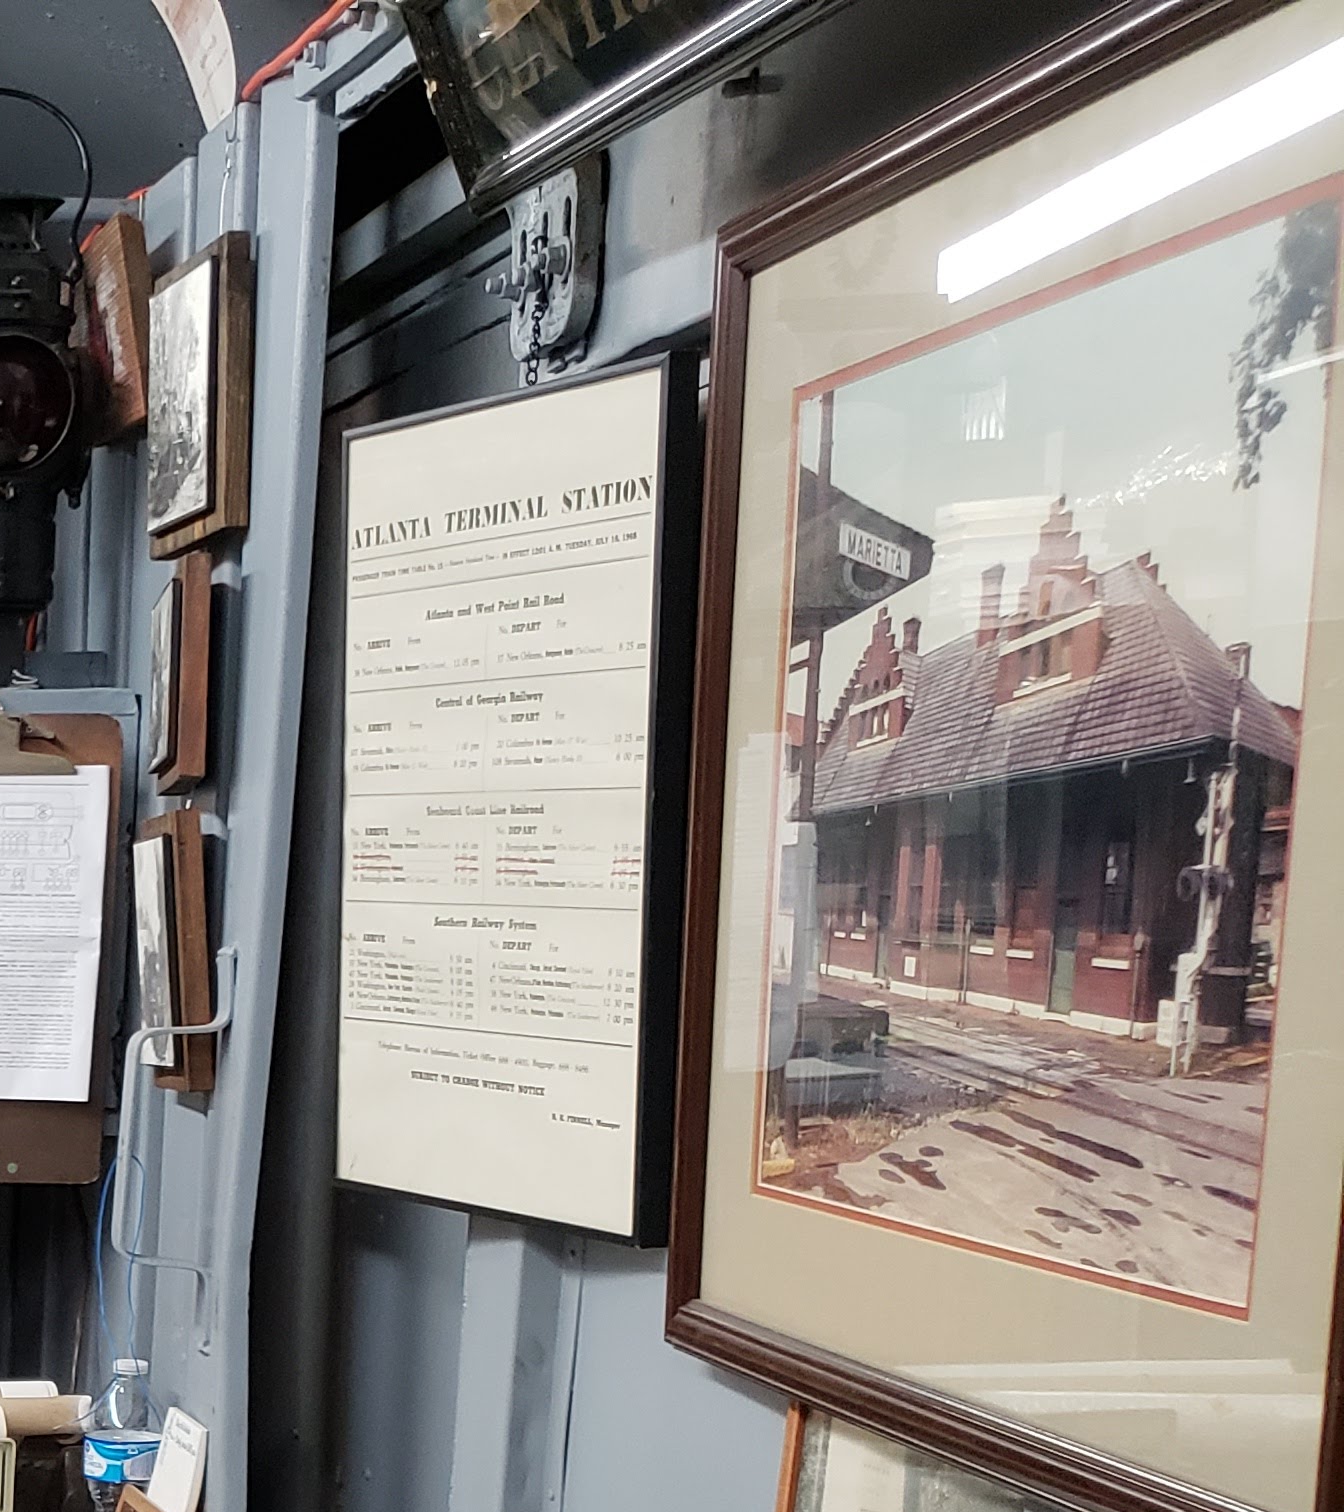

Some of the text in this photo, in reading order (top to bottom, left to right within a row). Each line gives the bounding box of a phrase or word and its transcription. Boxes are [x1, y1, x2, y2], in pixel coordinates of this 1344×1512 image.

[351, 475, 653, 550] ATLANTA TERMINAL STATION
[847, 528, 903, 575] MARIETTA
[425, 592, 565, 621] Atlanta and West Point Rail Road
[511, 621, 542, 634] DEPART
[435, 690, 544, 708] Central of Georgia Railway
[511, 711, 540, 723] DEPART
[426, 805, 462, 816] Seaboard
[465, 805, 486, 816] Coast
[510, 803, 545, 816] Railroad
[508, 825, 538, 836] DEPART
[433, 916, 538, 931] Southern Railway System
[502, 941, 532, 952] DEPART
[441, 1074, 450, 1084] TO
[452, 1075, 480, 1088] CHANGE
[481, 1079, 515, 1093] WITHOUT
[517, 1084, 546, 1097] NOTICE
